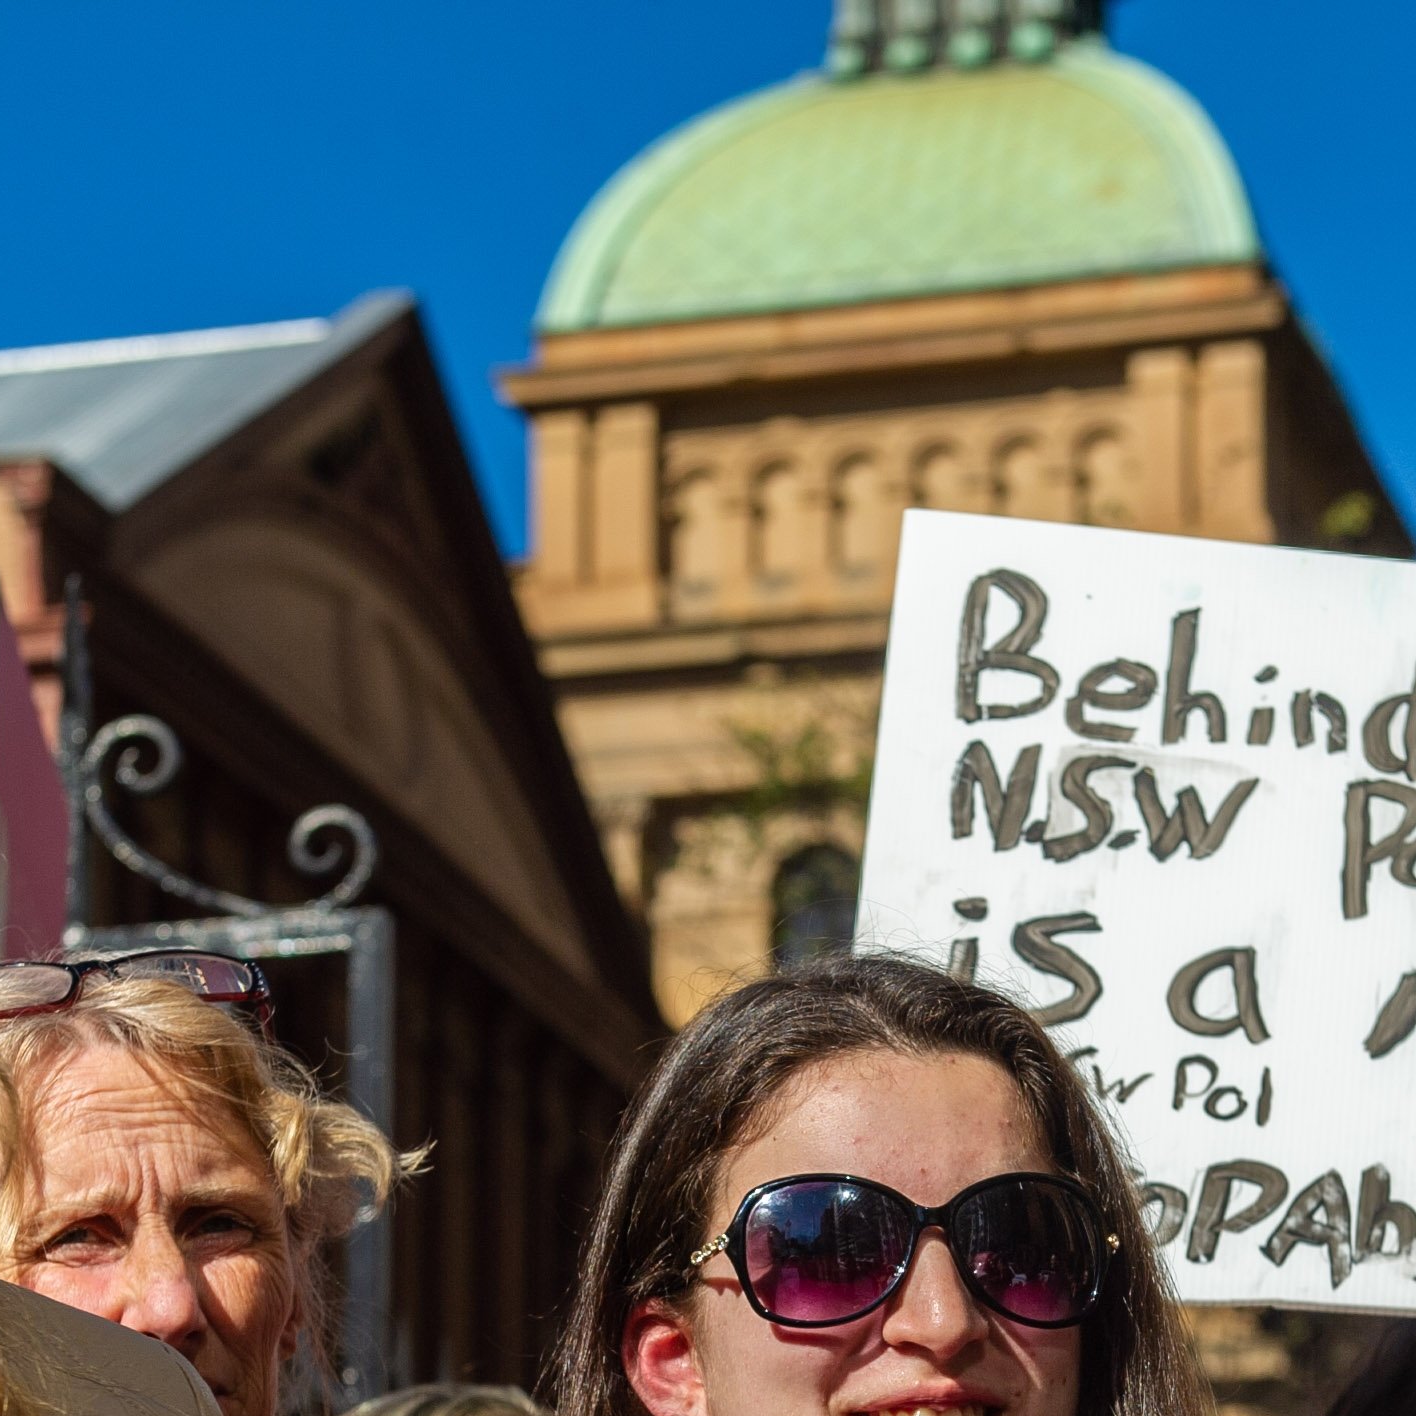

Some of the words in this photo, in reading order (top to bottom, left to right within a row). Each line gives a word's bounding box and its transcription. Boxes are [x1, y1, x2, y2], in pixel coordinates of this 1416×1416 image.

[949, 897, 1104, 1026] is
[1166, 945, 1272, 1045] a
[1172, 1054, 1274, 1127] Pol
